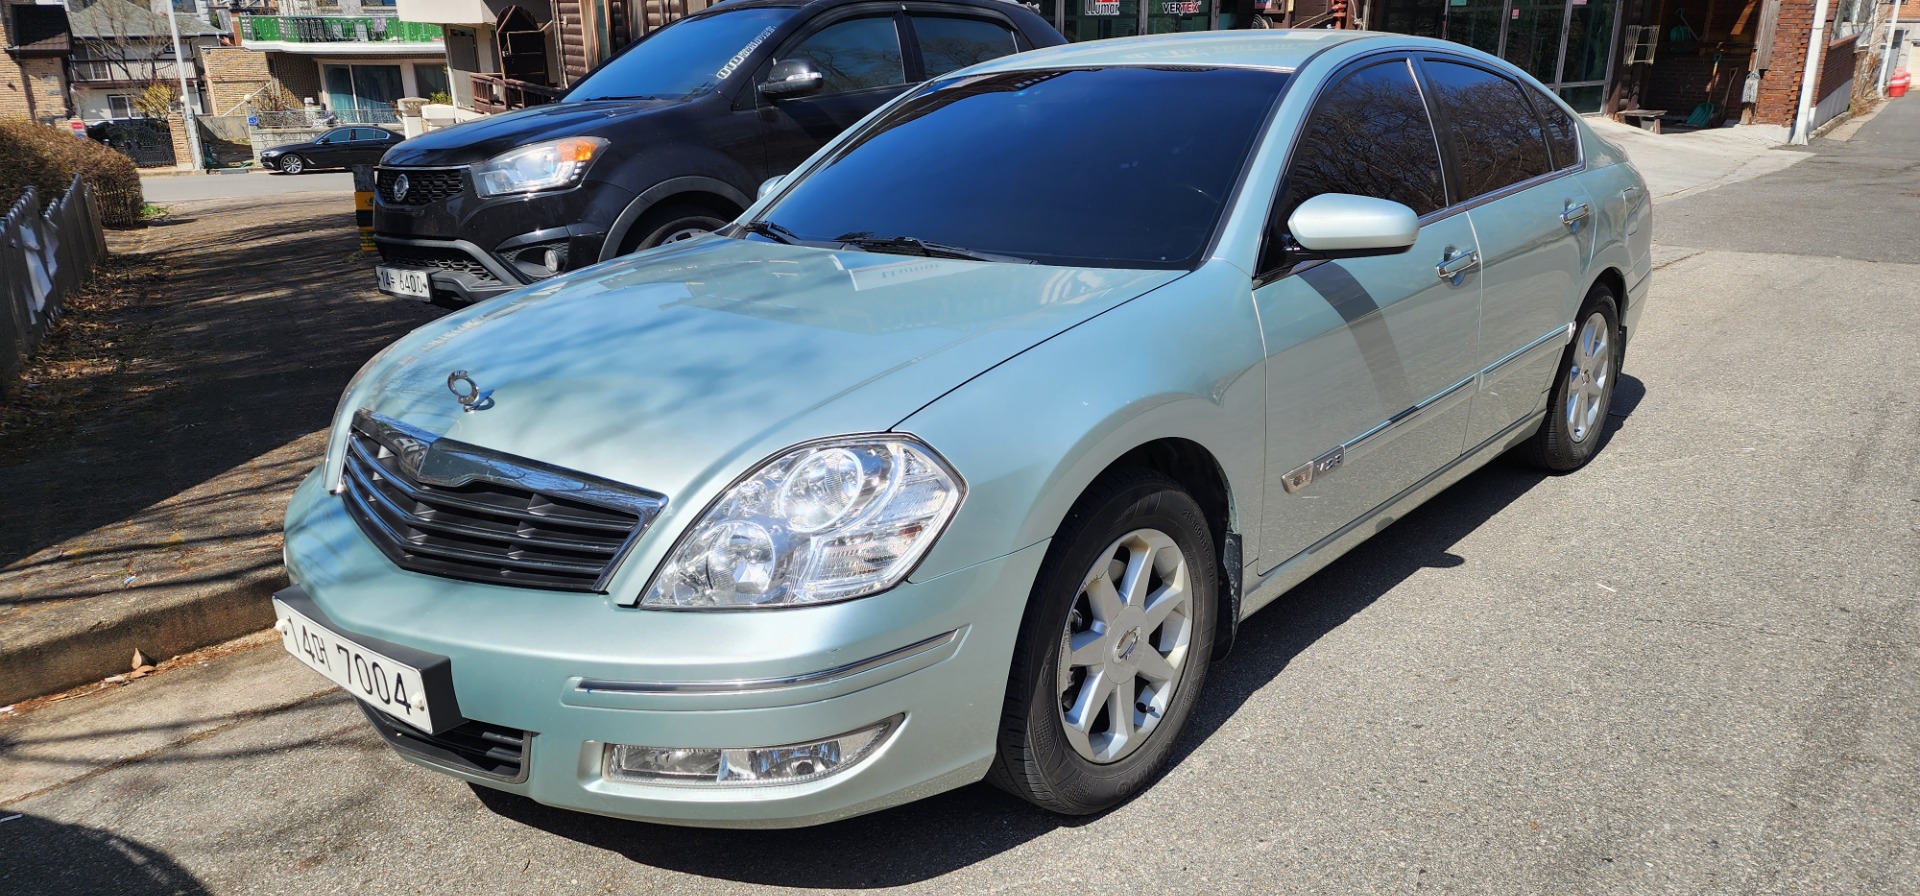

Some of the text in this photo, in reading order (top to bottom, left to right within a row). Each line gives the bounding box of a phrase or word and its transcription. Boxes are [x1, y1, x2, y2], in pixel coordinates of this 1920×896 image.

[1162, 1, 1199, 16] VERTEX
[286, 615, 412, 716] 14머 7004
